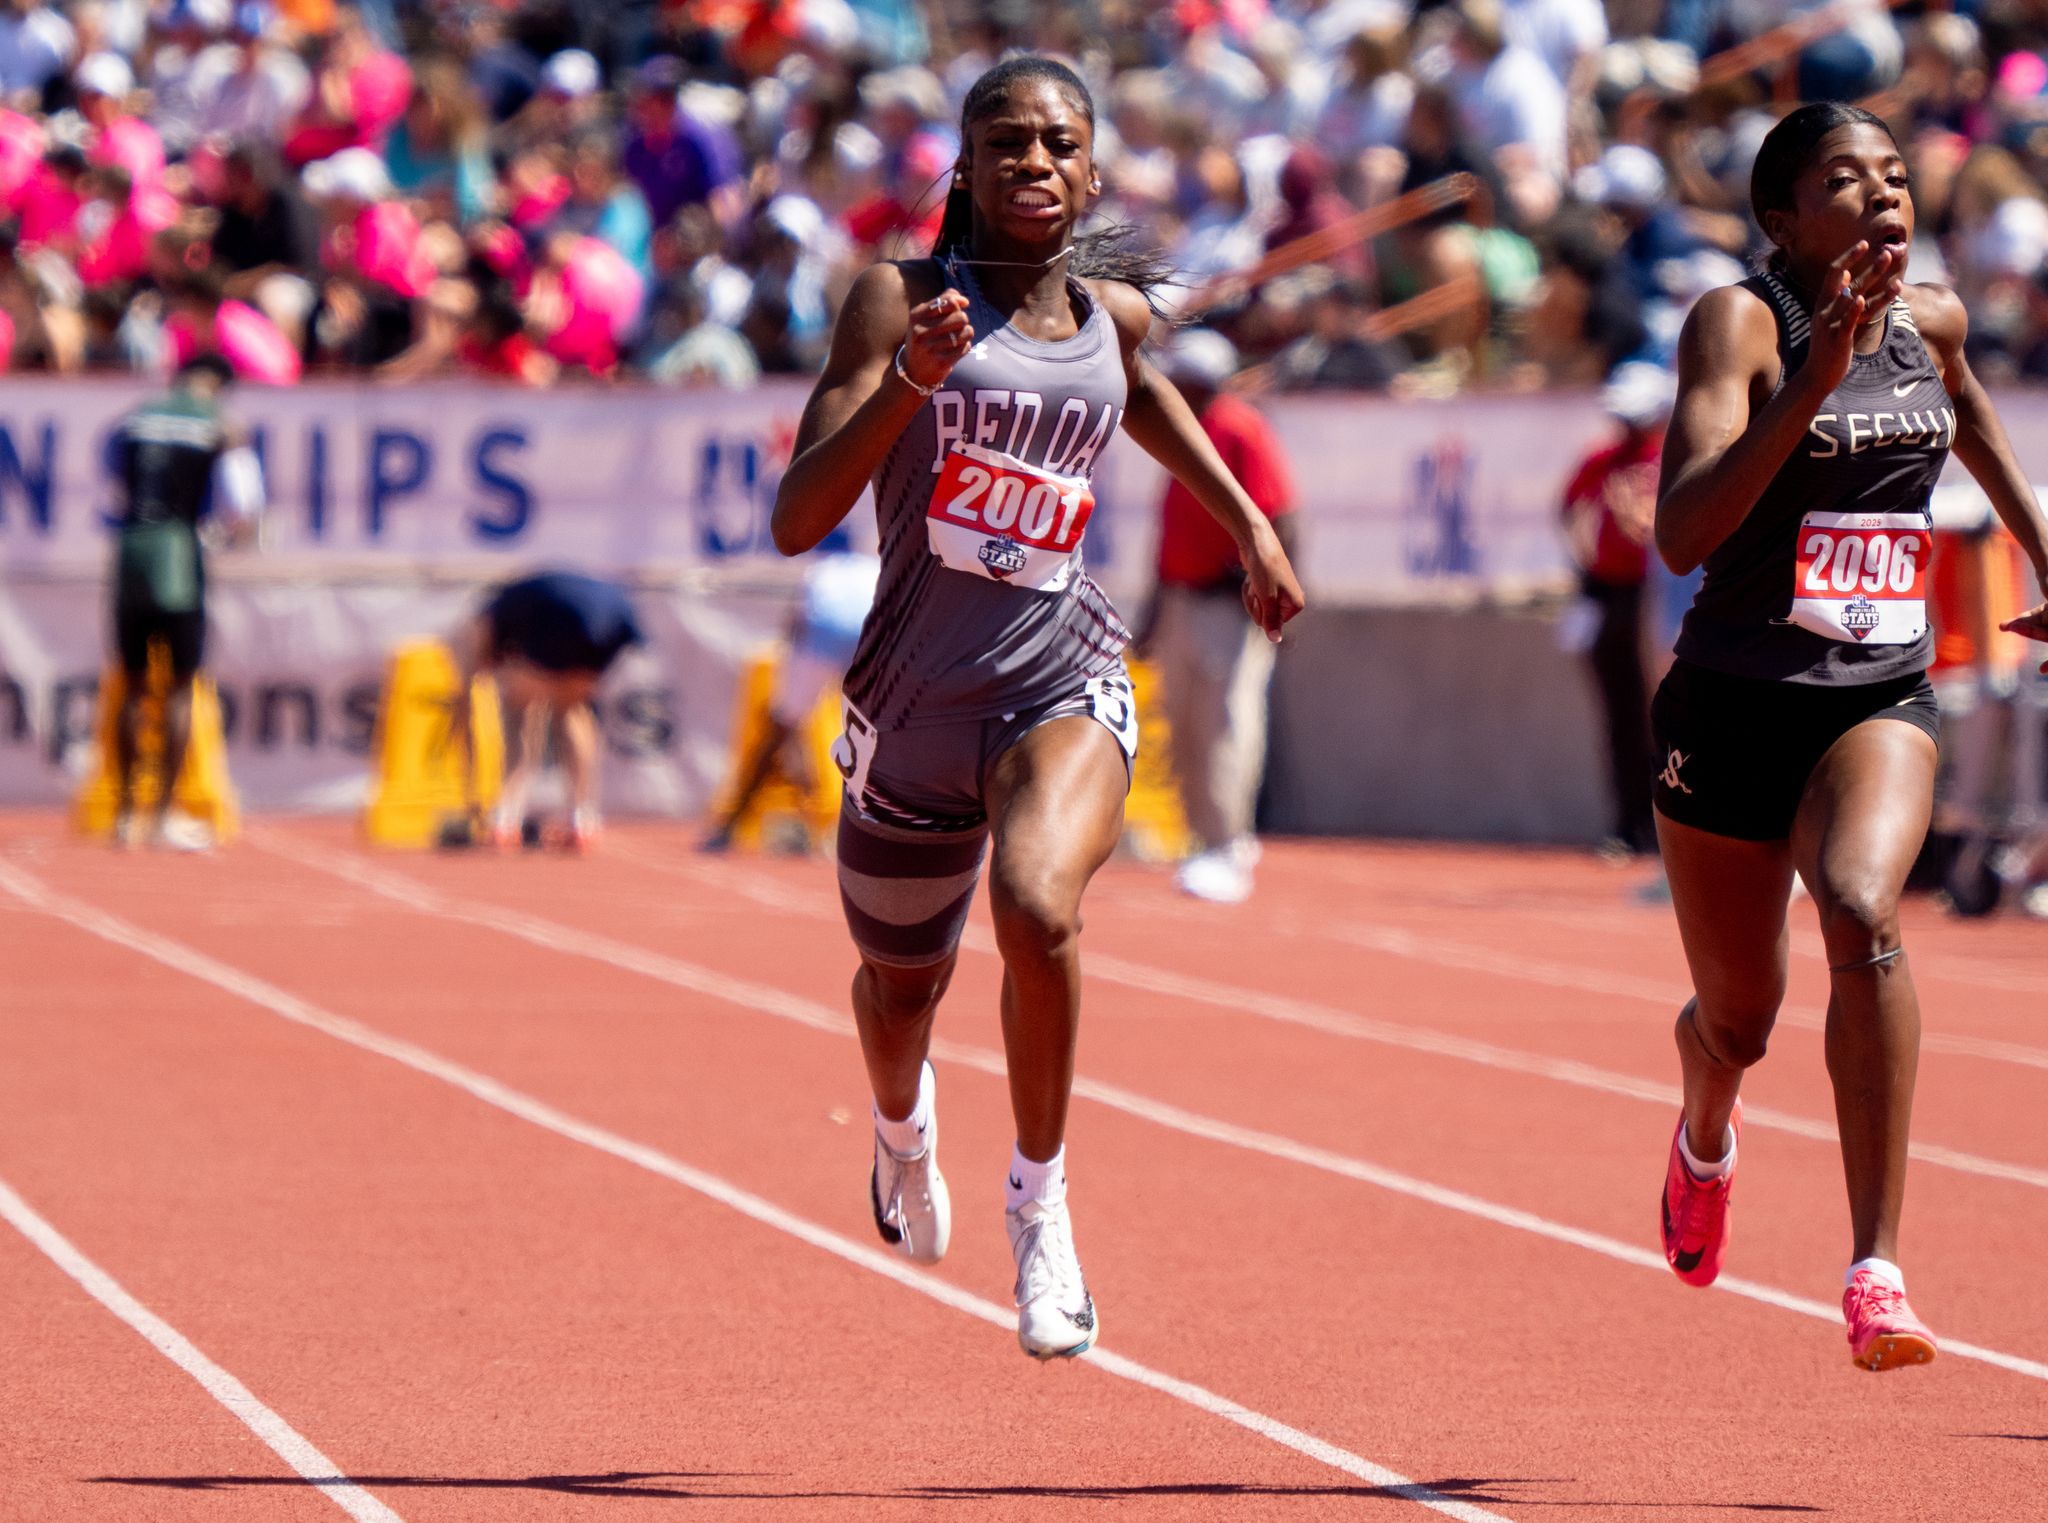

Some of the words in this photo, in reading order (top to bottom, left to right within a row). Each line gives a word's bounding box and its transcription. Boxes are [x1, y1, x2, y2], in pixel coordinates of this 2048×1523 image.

[1041, 397, 1124, 474] OA
[946, 466, 1081, 544] 2001
[979, 547, 1026, 570] STATE
[1805, 534, 1920, 592] 2096
[1841, 612, 1879, 625] STATE
[835, 706, 868, 779] 5
